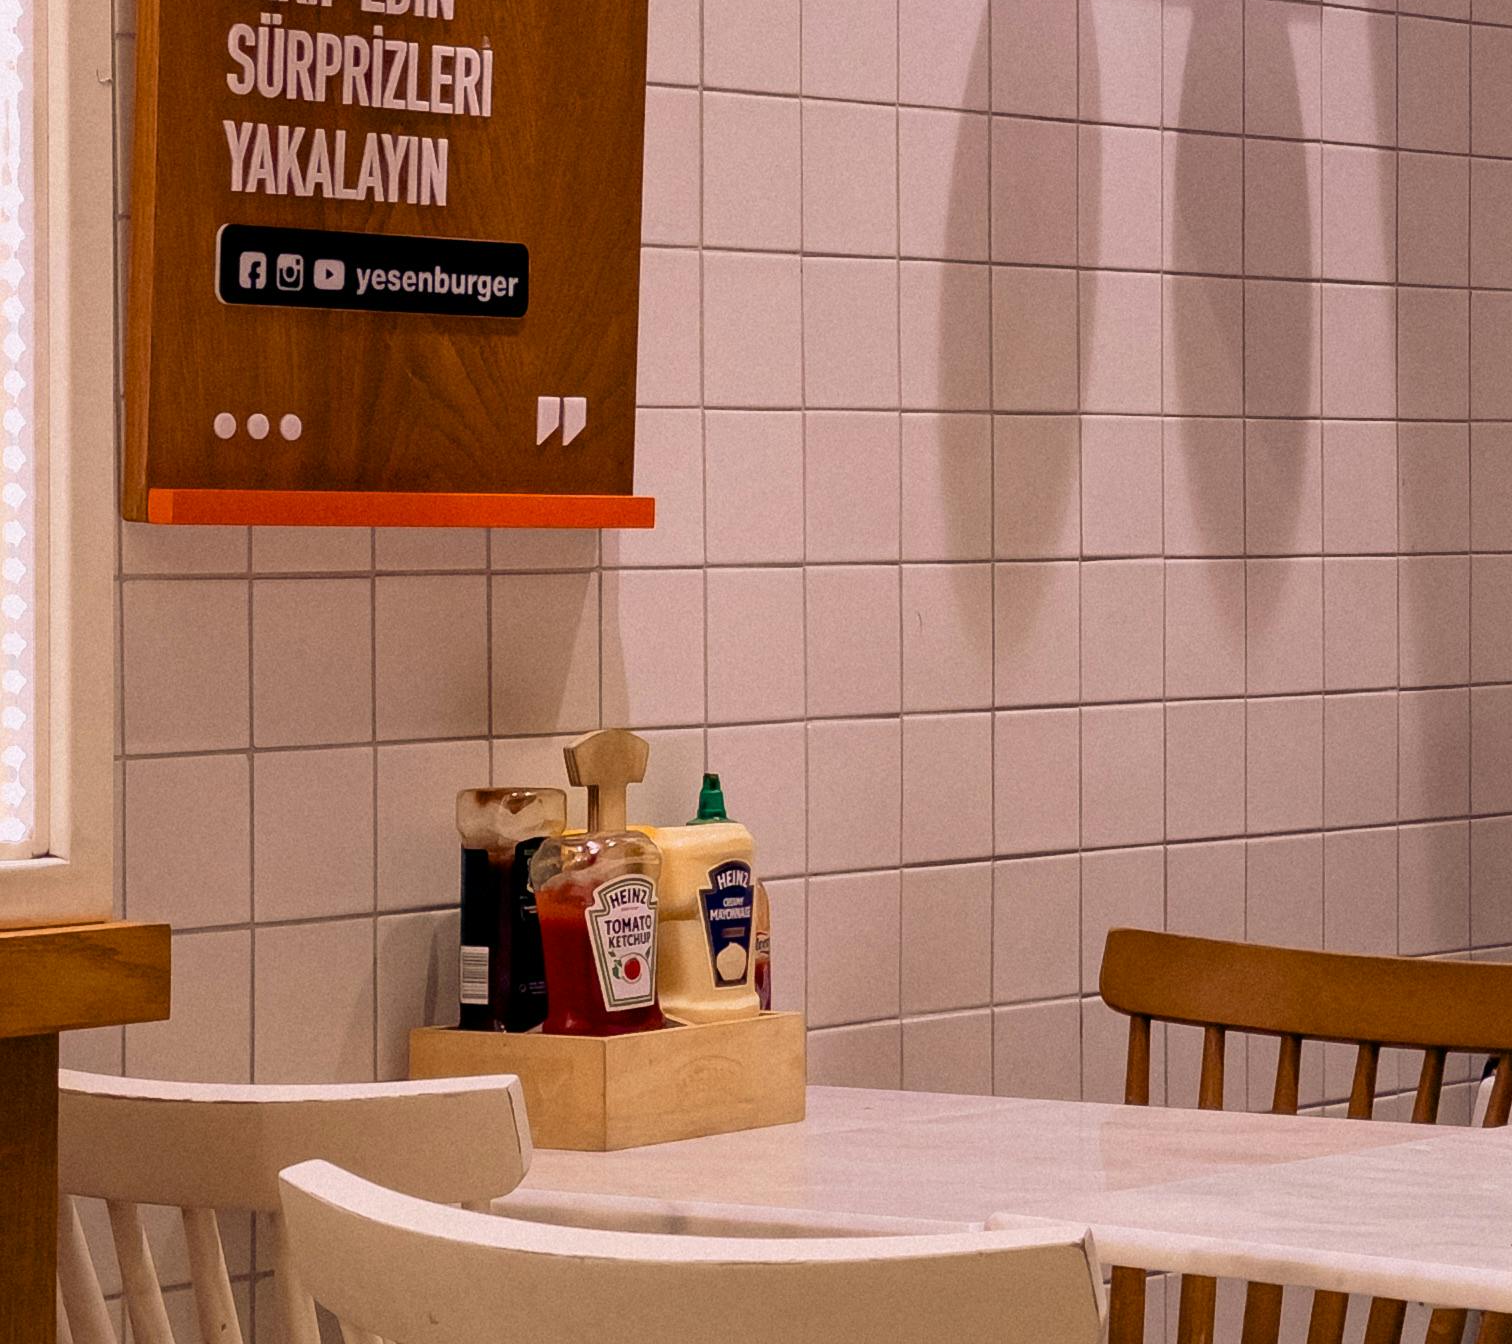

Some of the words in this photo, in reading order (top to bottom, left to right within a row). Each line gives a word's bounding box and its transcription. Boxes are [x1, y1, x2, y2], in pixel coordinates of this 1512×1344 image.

[226, 12, 493, 117] SÜRPRİZLERİ
[222, 119, 449, 206] YAKALAYIN
[356, 265, 519, 302] yesenburger
[717, 869, 749, 890] HEINZ
[609, 887, 648, 909] HEINZ
[604, 914, 652, 936] TOMATO
[608, 931, 651, 949] KETCHUP
